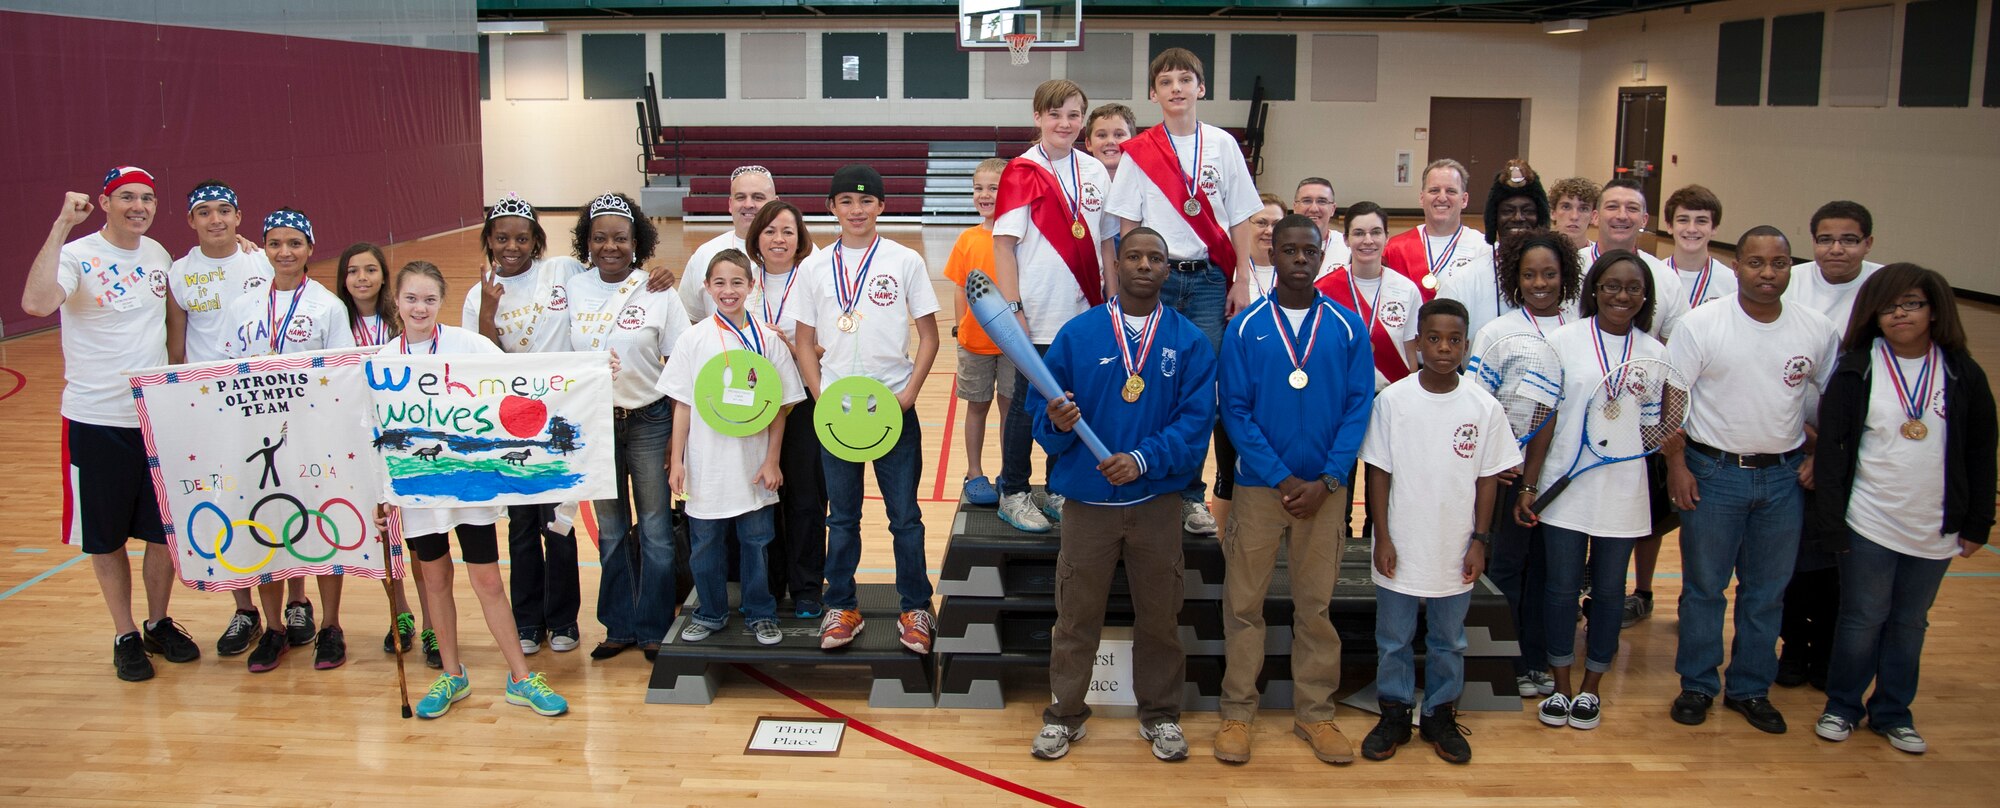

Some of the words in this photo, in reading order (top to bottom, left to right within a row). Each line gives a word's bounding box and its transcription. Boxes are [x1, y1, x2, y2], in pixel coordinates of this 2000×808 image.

[81, 257, 101, 273] DO
[97, 263, 120, 285] IT
[184, 266, 226, 287] Work
[197, 285, 208, 298] it
[874, 291, 893, 300] HAWC
[187, 293, 221, 312] Hard
[288, 327, 307, 338] HAWC
[216, 373, 309, 393] PATRONIS
[364, 360, 576, 400] Wehmeyer
[225, 387, 306, 407] OLYMPIC
[241, 401, 290, 417] TEAM
[299, 463, 337, 479] 2014
[1093, 651, 1116, 666] rst
[1089, 679, 1119, 692] ace
[775, 725, 823, 735] Third
[773, 737, 818, 746] Place
